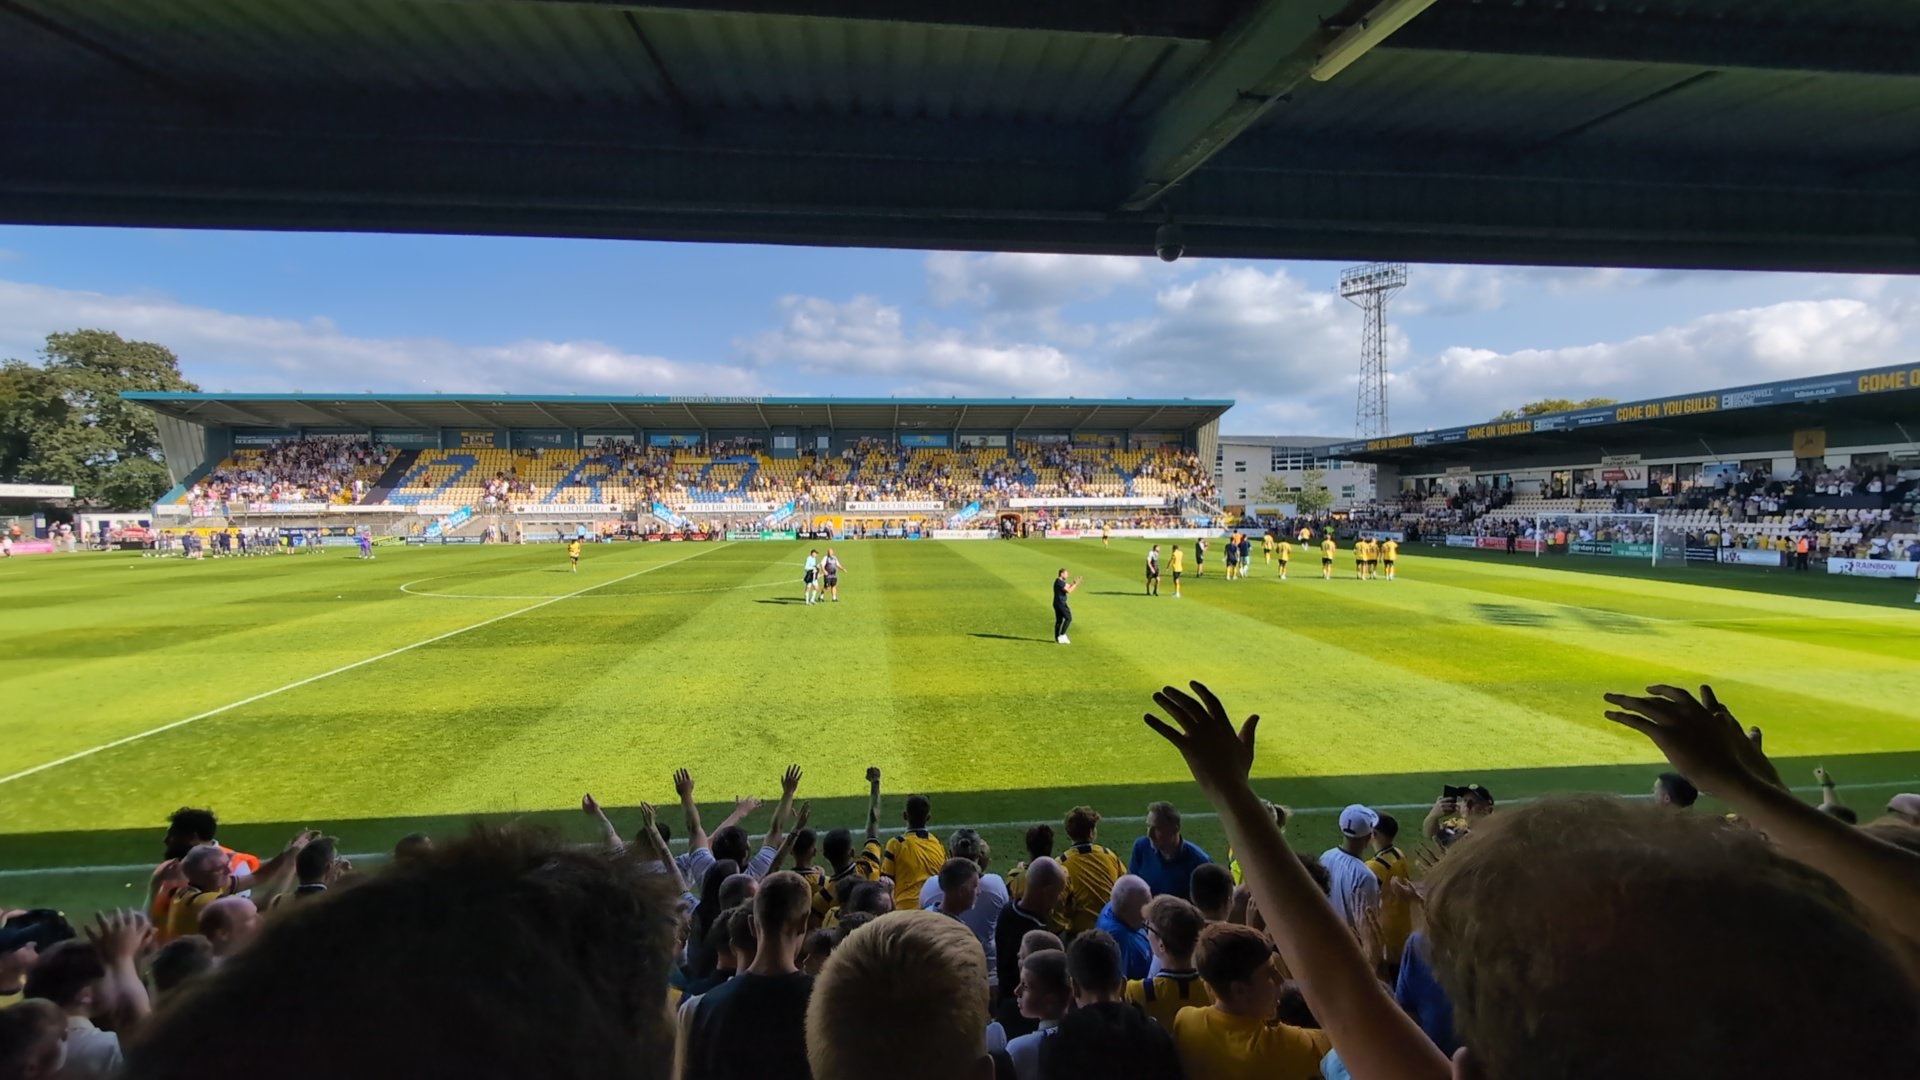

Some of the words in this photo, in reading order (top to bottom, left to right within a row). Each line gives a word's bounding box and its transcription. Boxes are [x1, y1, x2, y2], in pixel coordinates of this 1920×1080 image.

[1857, 370, 1905, 393] COME
[1909, 368, 1920, 387] O
[1616, 405, 1643, 422] COME
[1645, 403, 1660, 418] ON
[1662, 399, 1682, 416] YOU
[1683, 395, 1717, 412] GULLS
[1467, 427, 1486, 440] COME
[1486, 426, 1497, 437] ON
[1497, 423, 1510, 436] YOU
[1510, 420, 1531, 434] GULLS
[553, 504, 604, 513] FLOORING
[878, 502, 933, 510] DECORATION
[1855, 561, 1897, 571] RAINBOW
